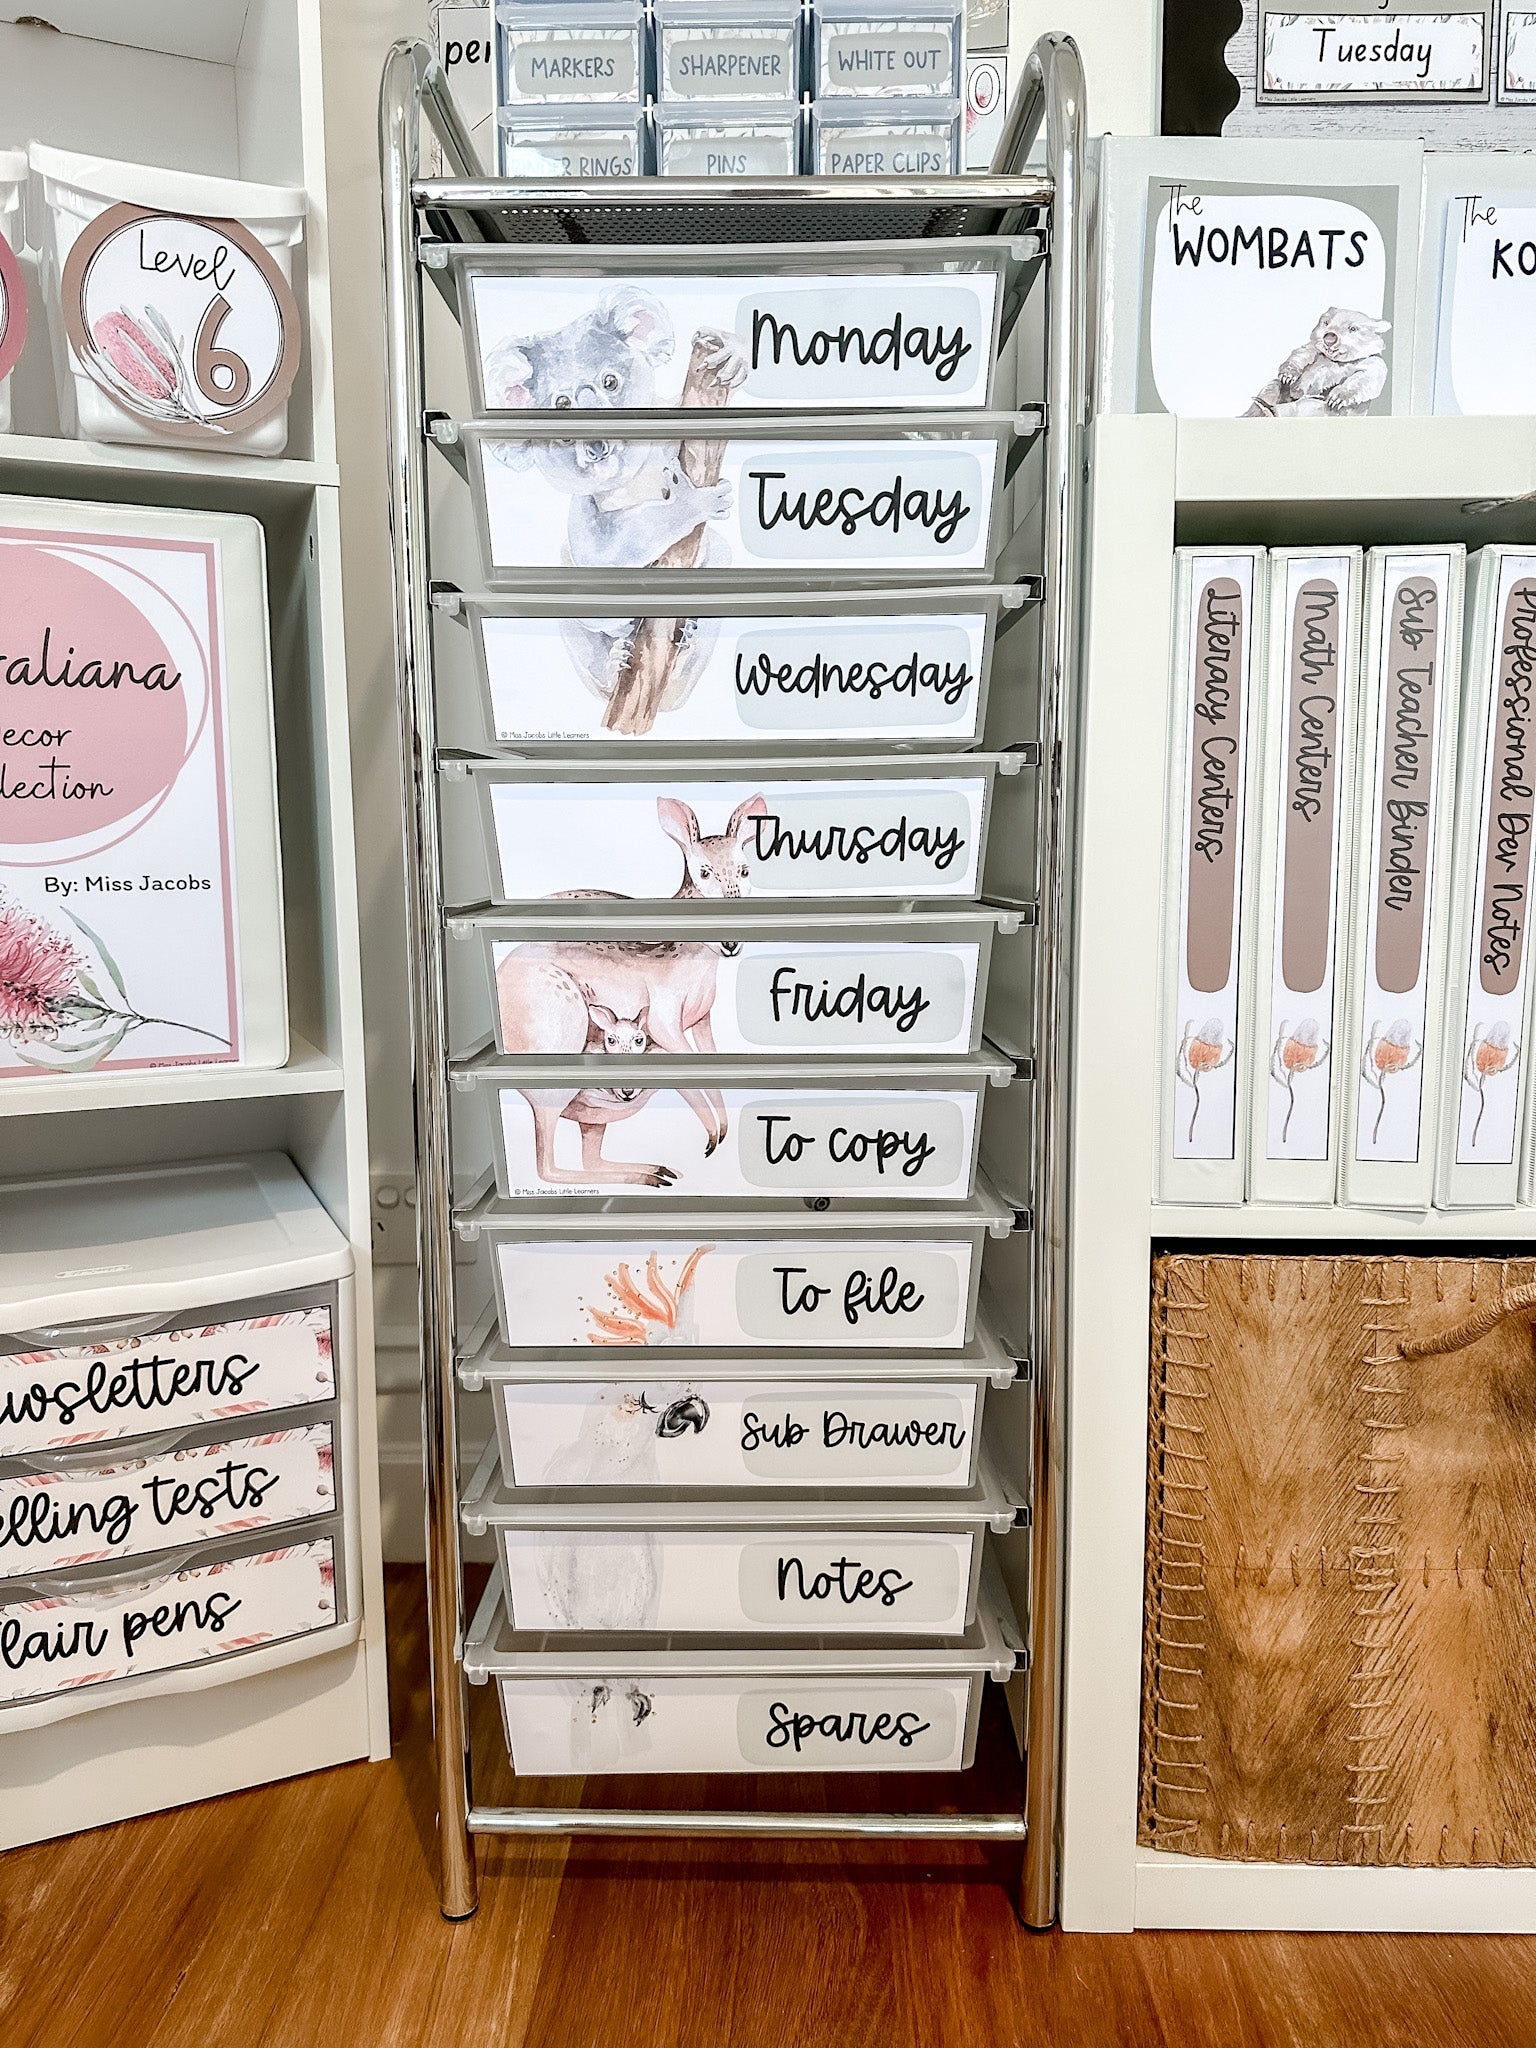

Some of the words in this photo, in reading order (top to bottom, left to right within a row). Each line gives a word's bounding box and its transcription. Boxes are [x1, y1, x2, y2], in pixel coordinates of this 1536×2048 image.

[532, 57, 614, 78] MARKERS
[680, 55, 780, 76] SHARPENER
[839, 49, 895, 71] WHITE
[904, 50, 941, 69] OUT
[1313, 29, 1431, 77] Tuesday
[580, 156, 632, 175] RINGS
[708, 154, 746, 174] PINS
[832, 153, 884, 173] PAPER
[893, 153, 941, 173] CLIPS
[1160, 184, 1203, 231] The
[1455, 196, 1498, 242] The
[140, 229, 236, 290] Level
[1173, 224, 1367, 269] WOMBATS
[1493, 239, 1536, 279] KO
[193, 293, 251, 406] 6
[752, 310, 971, 381] Monday
[749, 472, 970, 543] Tuesday
[1300, 591, 1338, 684] Math
[1398, 588, 1436, 651] Sub
[736, 652, 973, 704] Wednesday
[1195, 588, 1240, 725] Literacy
[0, 729, 72, 747] ecor
[1390, 661, 1433, 789] Teacher
[0, 756, 113, 799] lection
[1293, 696, 1335, 822] Centers
[1195, 737, 1236, 863] Centers
[748, 816, 965, 869] Thursday
[1385, 799, 1429, 911] Binder
[1495, 813, 1531, 872] Dev
[45, 877, 78, 893] By:
[86, 877, 132, 891] Miss
[140, 874, 211, 891] Jacobs
[1484, 885, 1523, 975] Notes
[770, 967, 930, 1032] Friday
[757, 1116, 815, 1164] To
[829, 1128, 935, 1176] copy
[773, 1268, 831, 1314] To
[844, 1267, 924, 1324] file
[0, 1354, 260, 1424] wsletters
[742, 1413, 809, 1450] Sub
[824, 1411, 966, 1448] Drawer
[142, 1460, 280, 1525] tests
[778, 1557, 913, 1606] Notes
[0, 1619, 108, 1669] lair
[124, 1591, 242, 1657] pens
[767, 1703, 930, 1752] Spares
